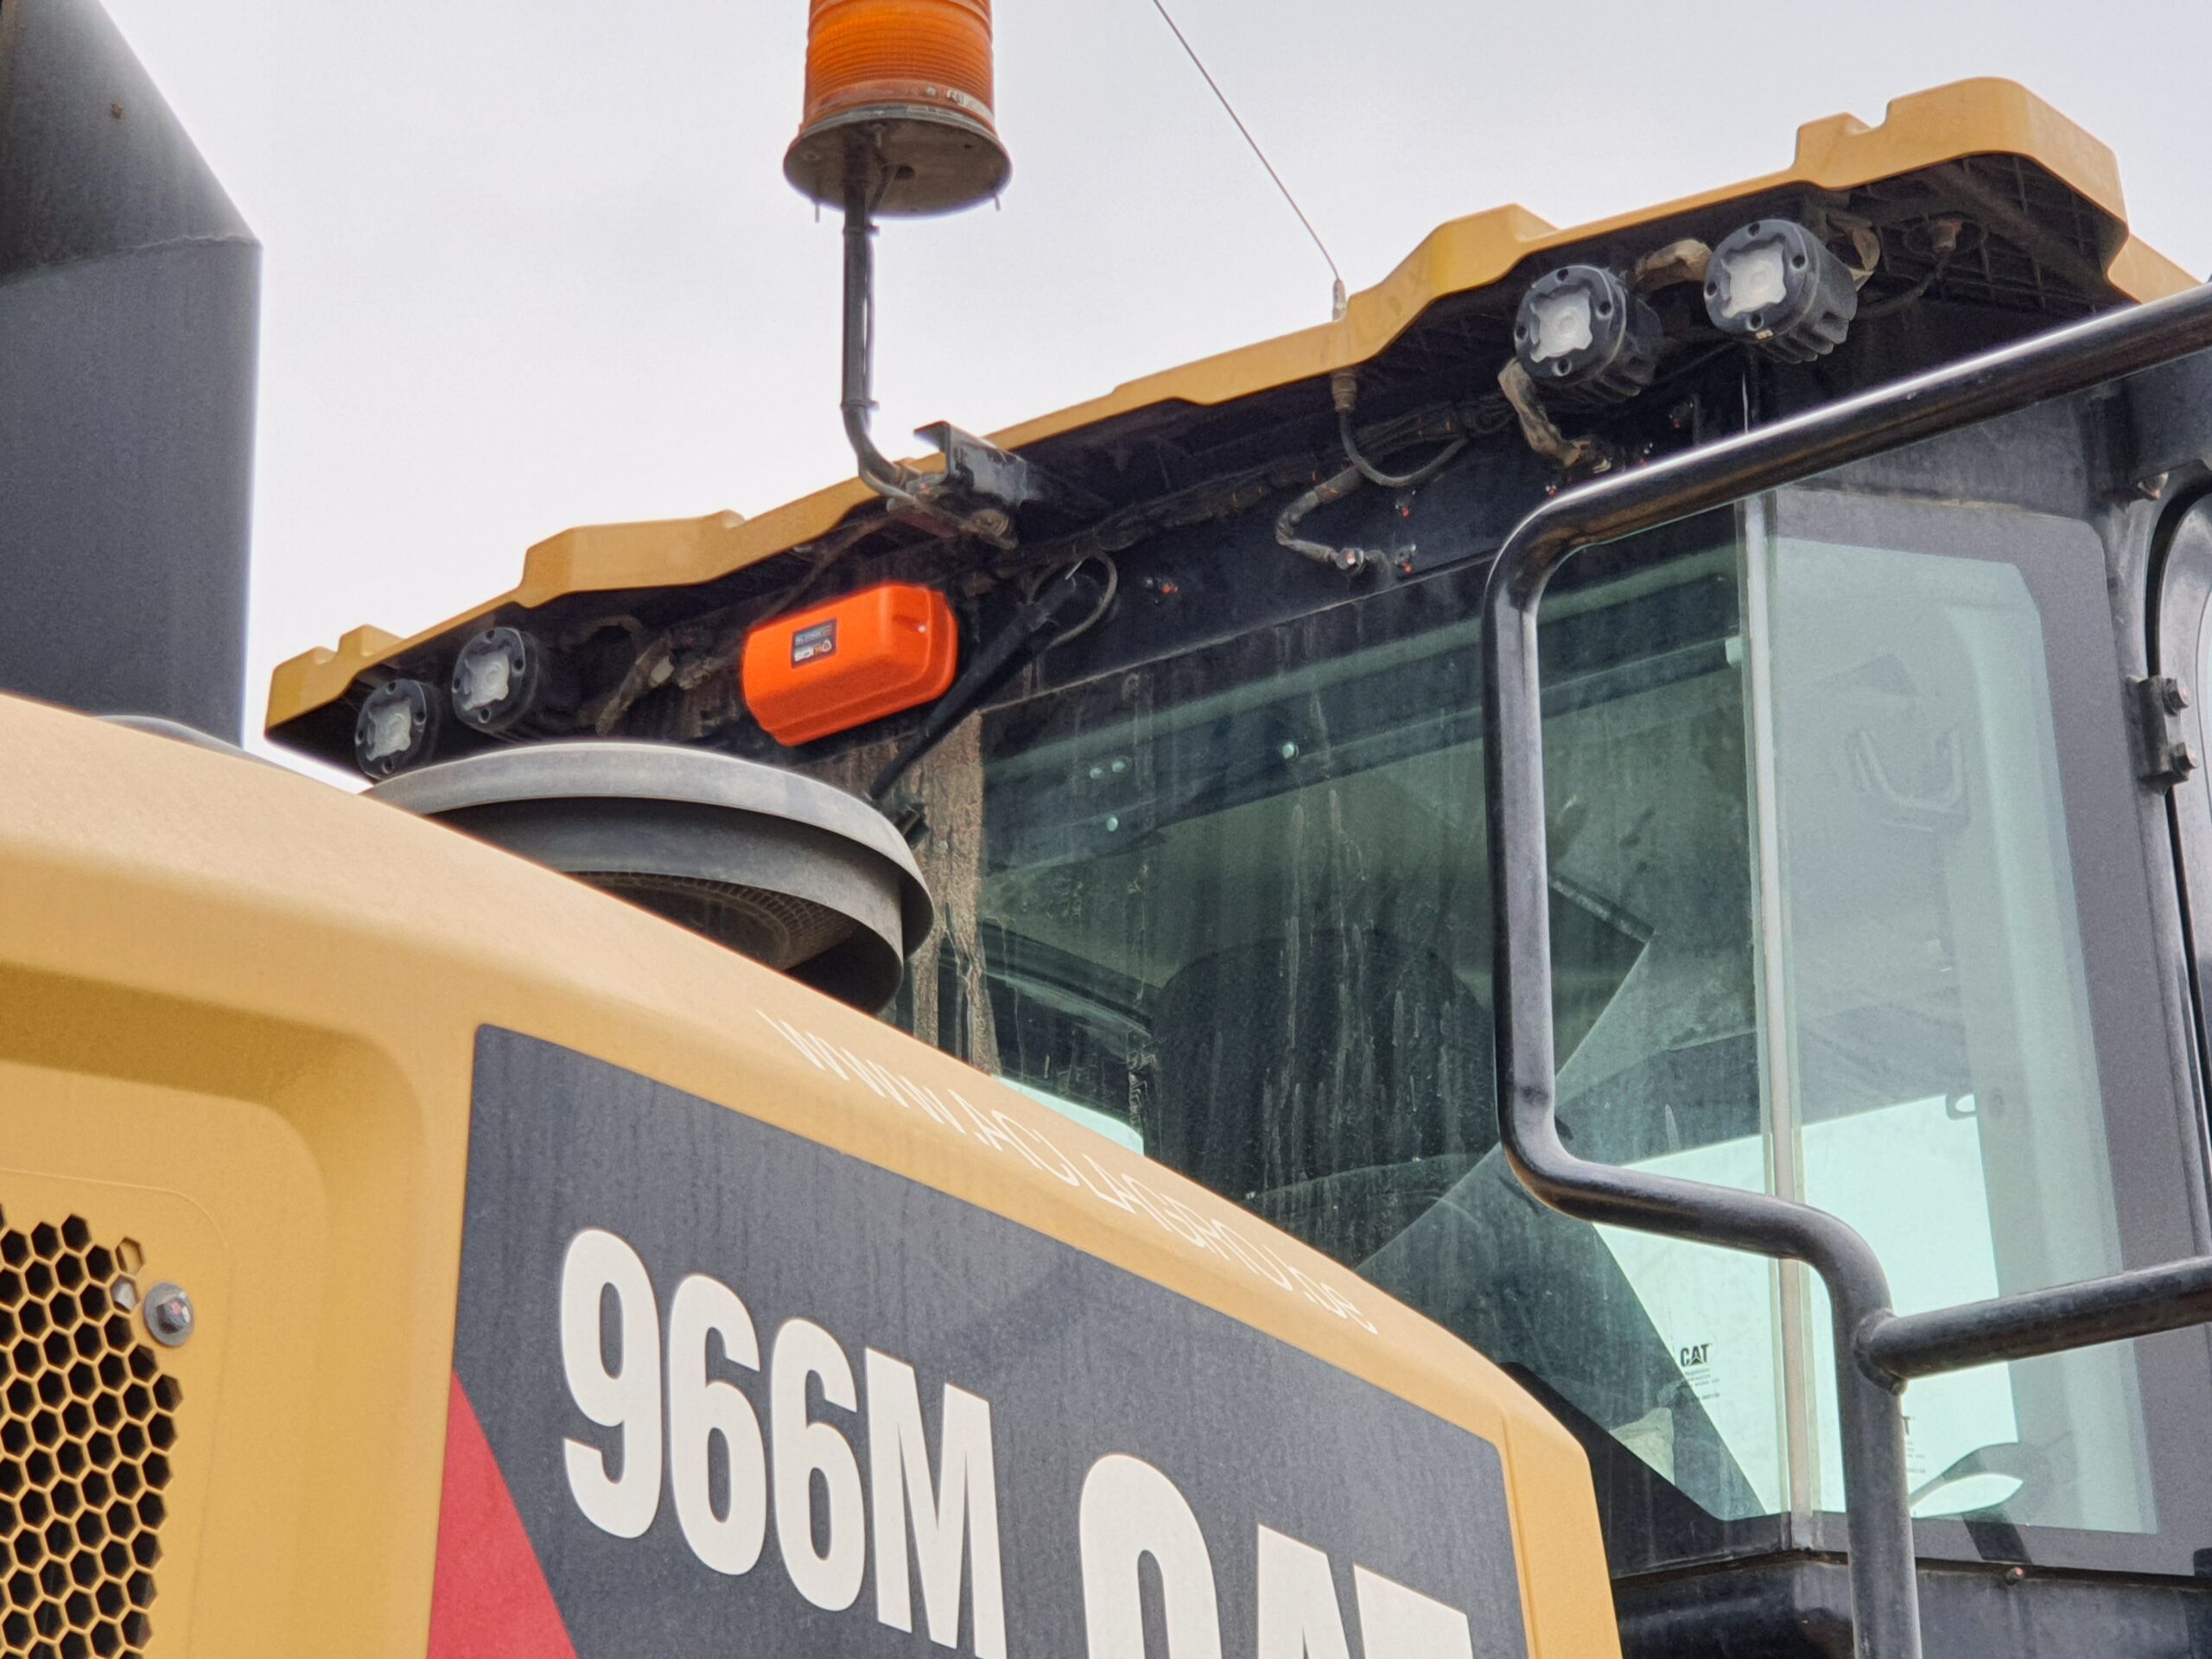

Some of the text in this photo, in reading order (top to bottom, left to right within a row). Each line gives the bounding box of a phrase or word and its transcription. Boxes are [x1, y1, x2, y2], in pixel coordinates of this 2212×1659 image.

[755, 1008, 1379, 1335] www.ACLAGRO.be
[560, 1229, 1007, 1659] 966M
[1680, 1342, 1710, 1368] CAT
